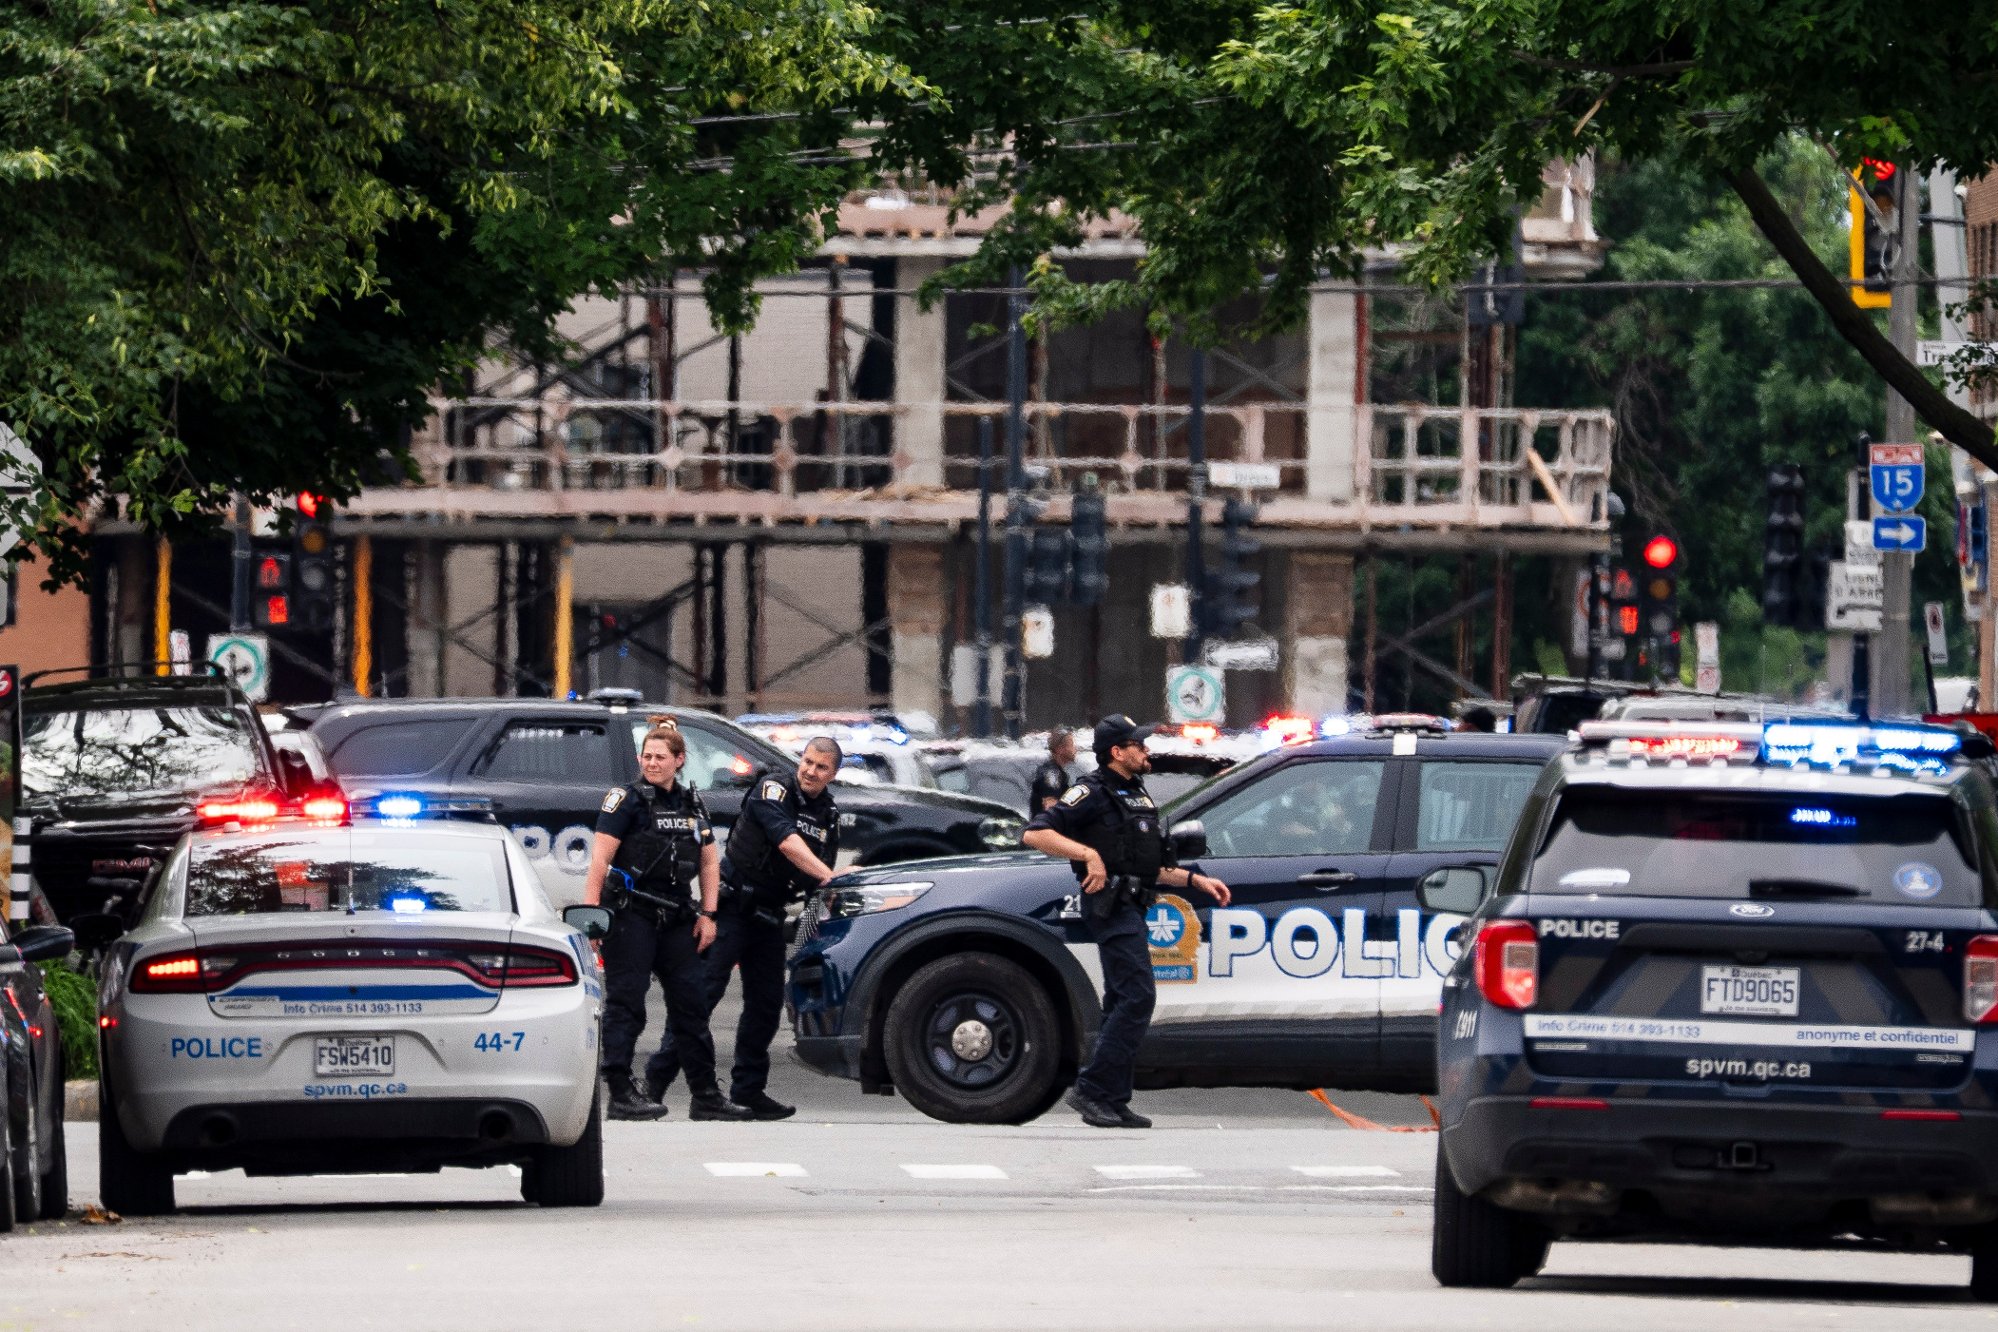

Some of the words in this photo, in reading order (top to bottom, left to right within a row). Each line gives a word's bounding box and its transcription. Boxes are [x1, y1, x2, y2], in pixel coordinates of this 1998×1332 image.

[1883, 469, 1914, 496] 15
[657, 818, 689, 829] POLICE
[796, 819, 821, 840] POLICE
[1540, 919, 1620, 938] POLICE
[1209, 907, 1462, 979] POLIC
[1905, 931, 1944, 953] 27-4
[1706, 977, 1795, 1004] FTD9065
[283, 1004, 306, 1014] Info
[309, 1003, 342, 1014] Crime
[346, 1003, 367, 1013] 514
[371, 1003, 422, 1013] 393-1133
[1537, 1019, 1562, 1032] Info
[1568, 1021, 1607, 1033] Crime
[474, 1031, 525, 1051] 44-7
[1796, 1029, 1861, 1043] anonyme
[1864, 1031, 1876, 1042] et
[1880, 1030, 1959, 1044] confidentiel
[171, 1037, 262, 1058] POLICE
[318, 1046, 392, 1066] FSW5410
[1686, 1058, 1811, 1080] spvm.qc.ca
[304, 1082, 408, 1098] spvm.qc.ca
